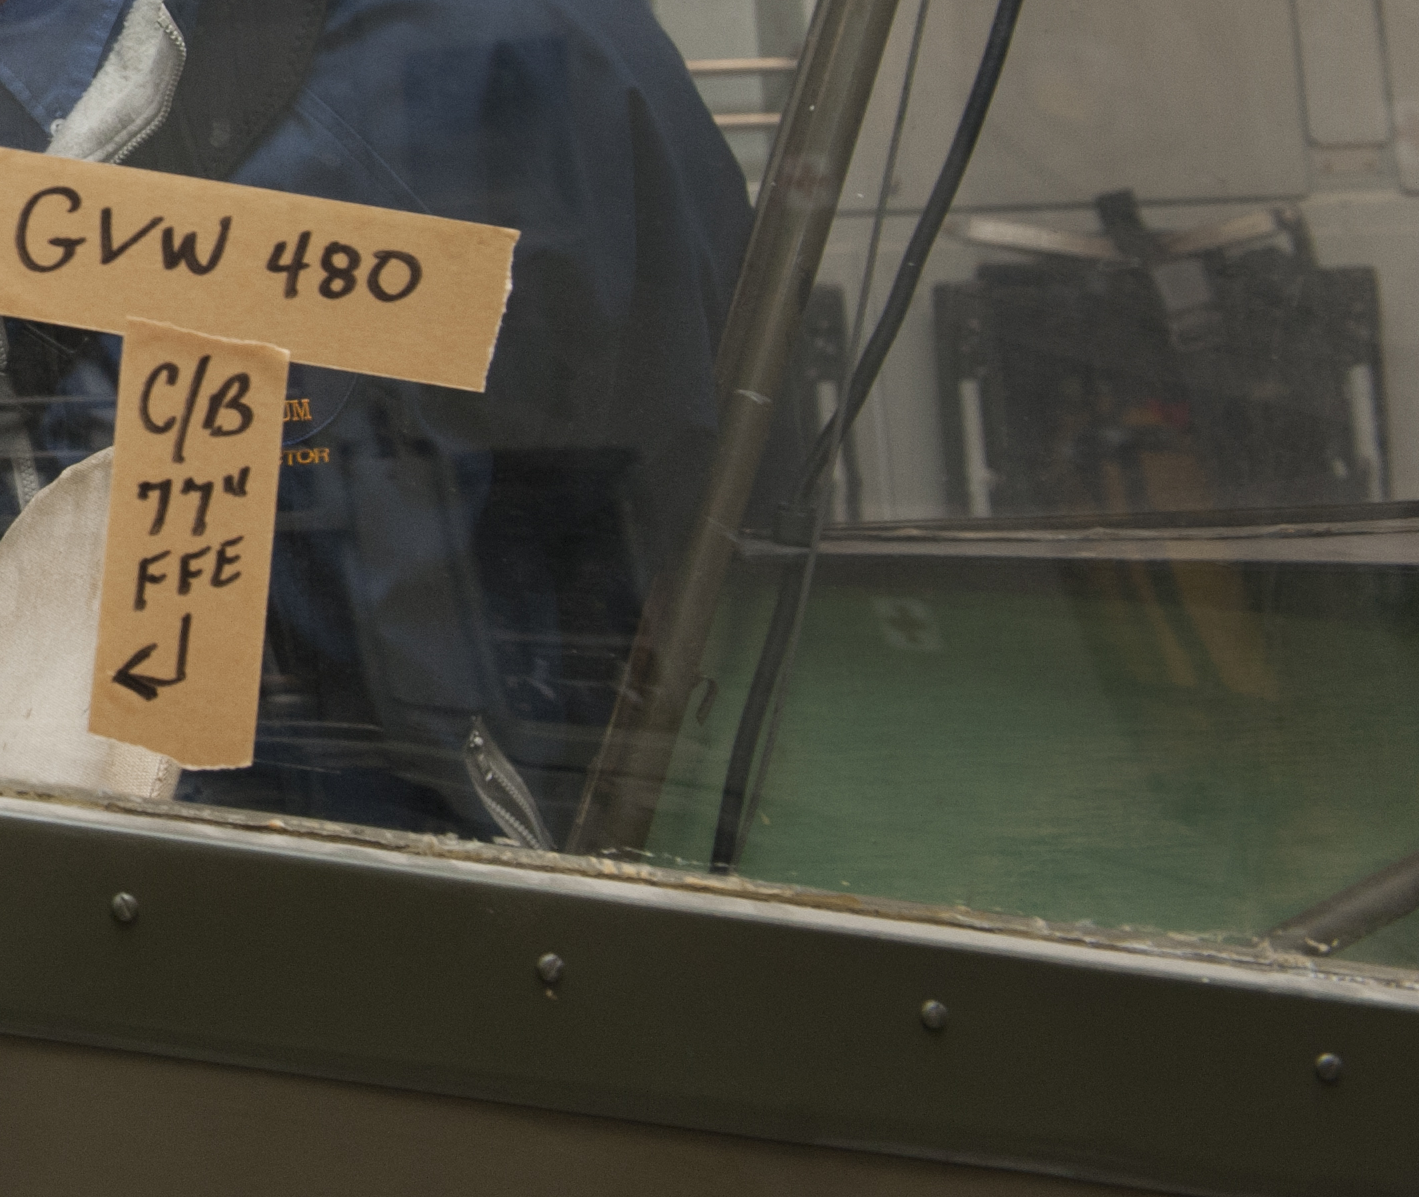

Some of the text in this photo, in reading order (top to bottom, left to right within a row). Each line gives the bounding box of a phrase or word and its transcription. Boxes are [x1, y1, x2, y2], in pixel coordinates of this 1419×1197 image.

[15, 185, 423, 303] GVW 480
[139, 355, 254, 463] C/B
[133, 536, 244, 611] FFE
